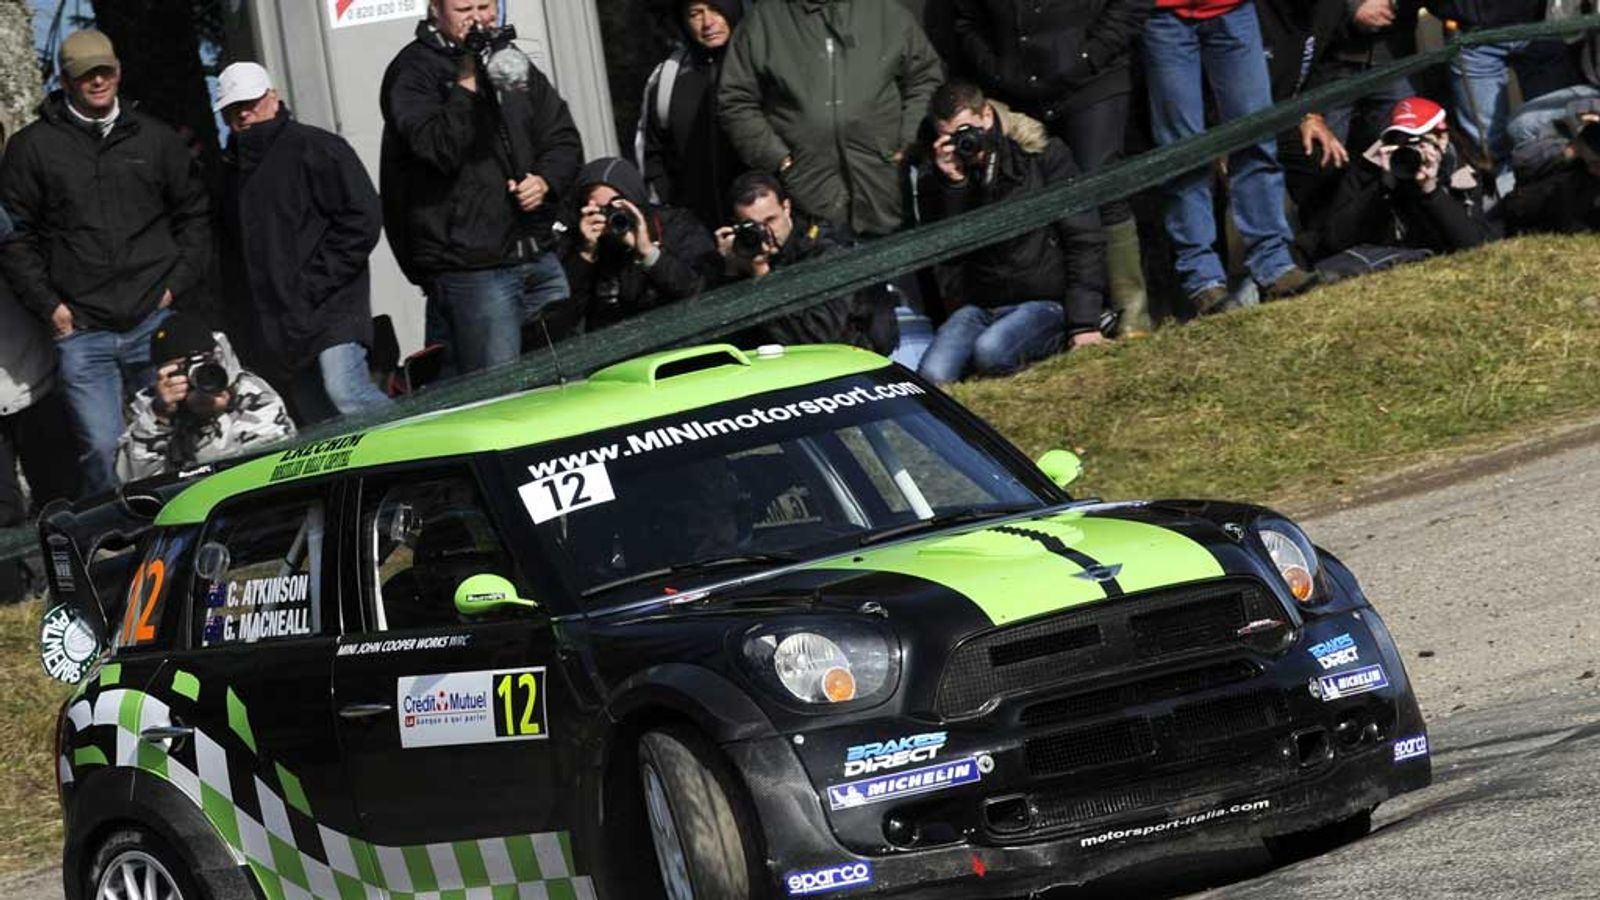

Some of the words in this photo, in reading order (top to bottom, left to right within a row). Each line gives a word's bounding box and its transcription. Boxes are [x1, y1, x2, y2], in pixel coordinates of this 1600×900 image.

[528, 378, 926, 480] www.MINImotorsport.com
[541, 471, 593, 512] 12
[123, 559, 165, 642] 12
[226, 581, 239, 607] C.
[242, 574, 309, 606] ATKINSON
[223, 614, 236, 641] G.
[239, 608, 311, 640] MACNEALL
[42, 608, 82, 684] PALMEIRAS
[356, 642, 382, 654] JOHN
[381, 639, 417, 652] COOPER
[416, 636, 449, 649] WORKS
[1308, 633, 1355, 658] BRAKES
[1317, 646, 1360, 670] DIRECT
[1337, 669, 1381, 690] MICHELIN
[449, 691, 487, 710] Mutuel
[497, 673, 540, 736] 12
[844, 743, 945, 777] DIRECT
[846, 731, 949, 761] BRAKES
[1394, 735, 1427, 760] sparco
[867, 763, 971, 797] MICHELIN
[1080, 800, 1270, 847] motorsport-italia.com
[788, 863, 869, 893] sparco
